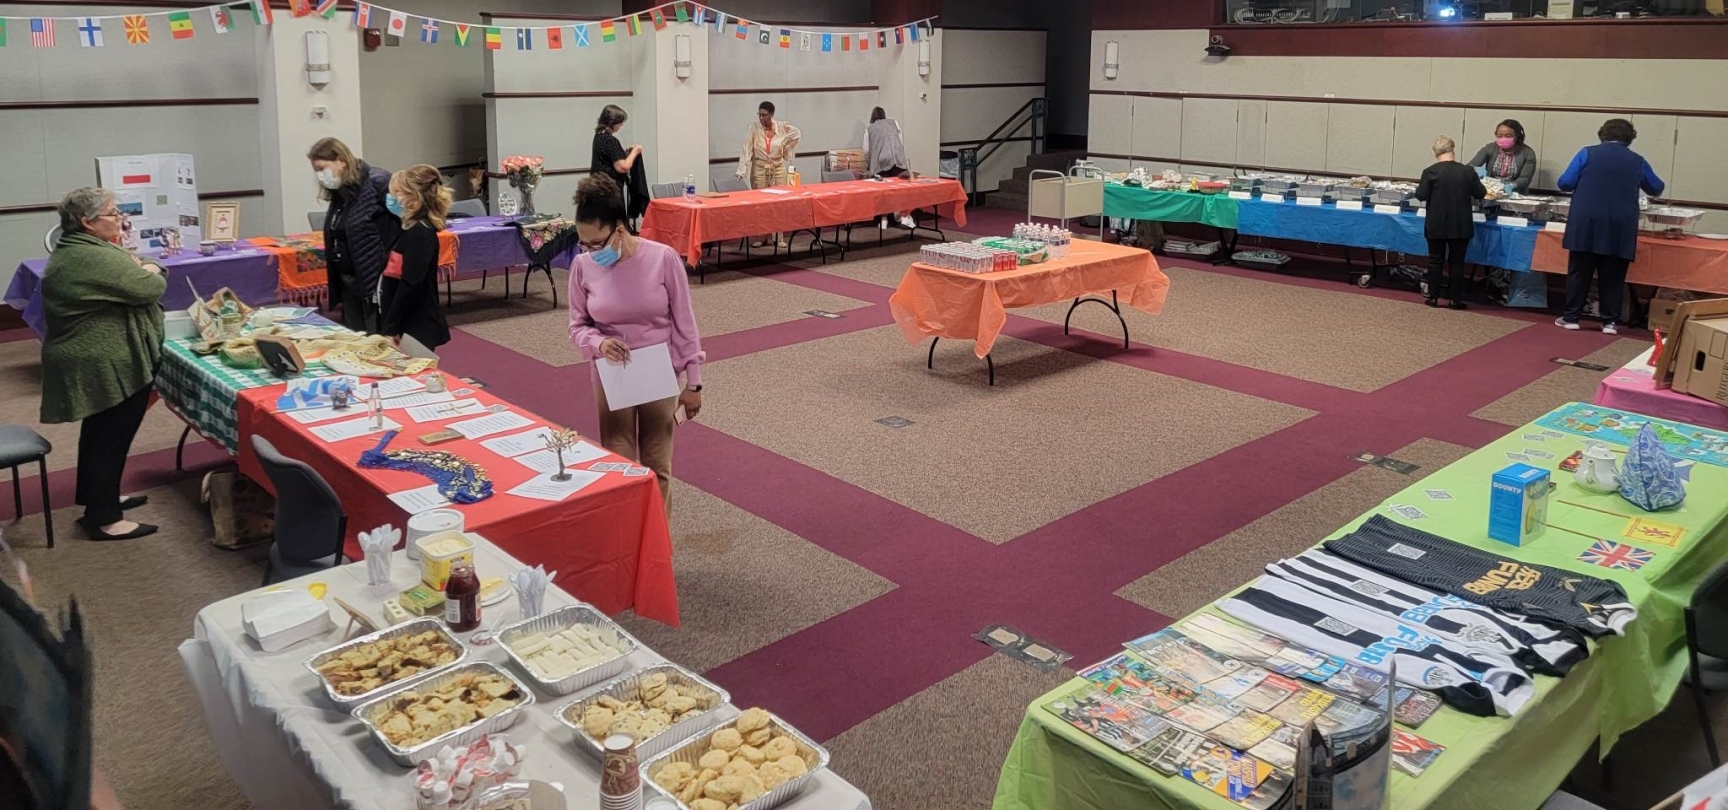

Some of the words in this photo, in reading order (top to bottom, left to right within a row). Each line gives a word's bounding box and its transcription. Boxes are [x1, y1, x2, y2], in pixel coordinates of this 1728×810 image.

[1492, 481, 1522, 494] BOUNTY
[1462, 561, 1519, 595] FUN88
[1355, 623, 1419, 665] FUN88
